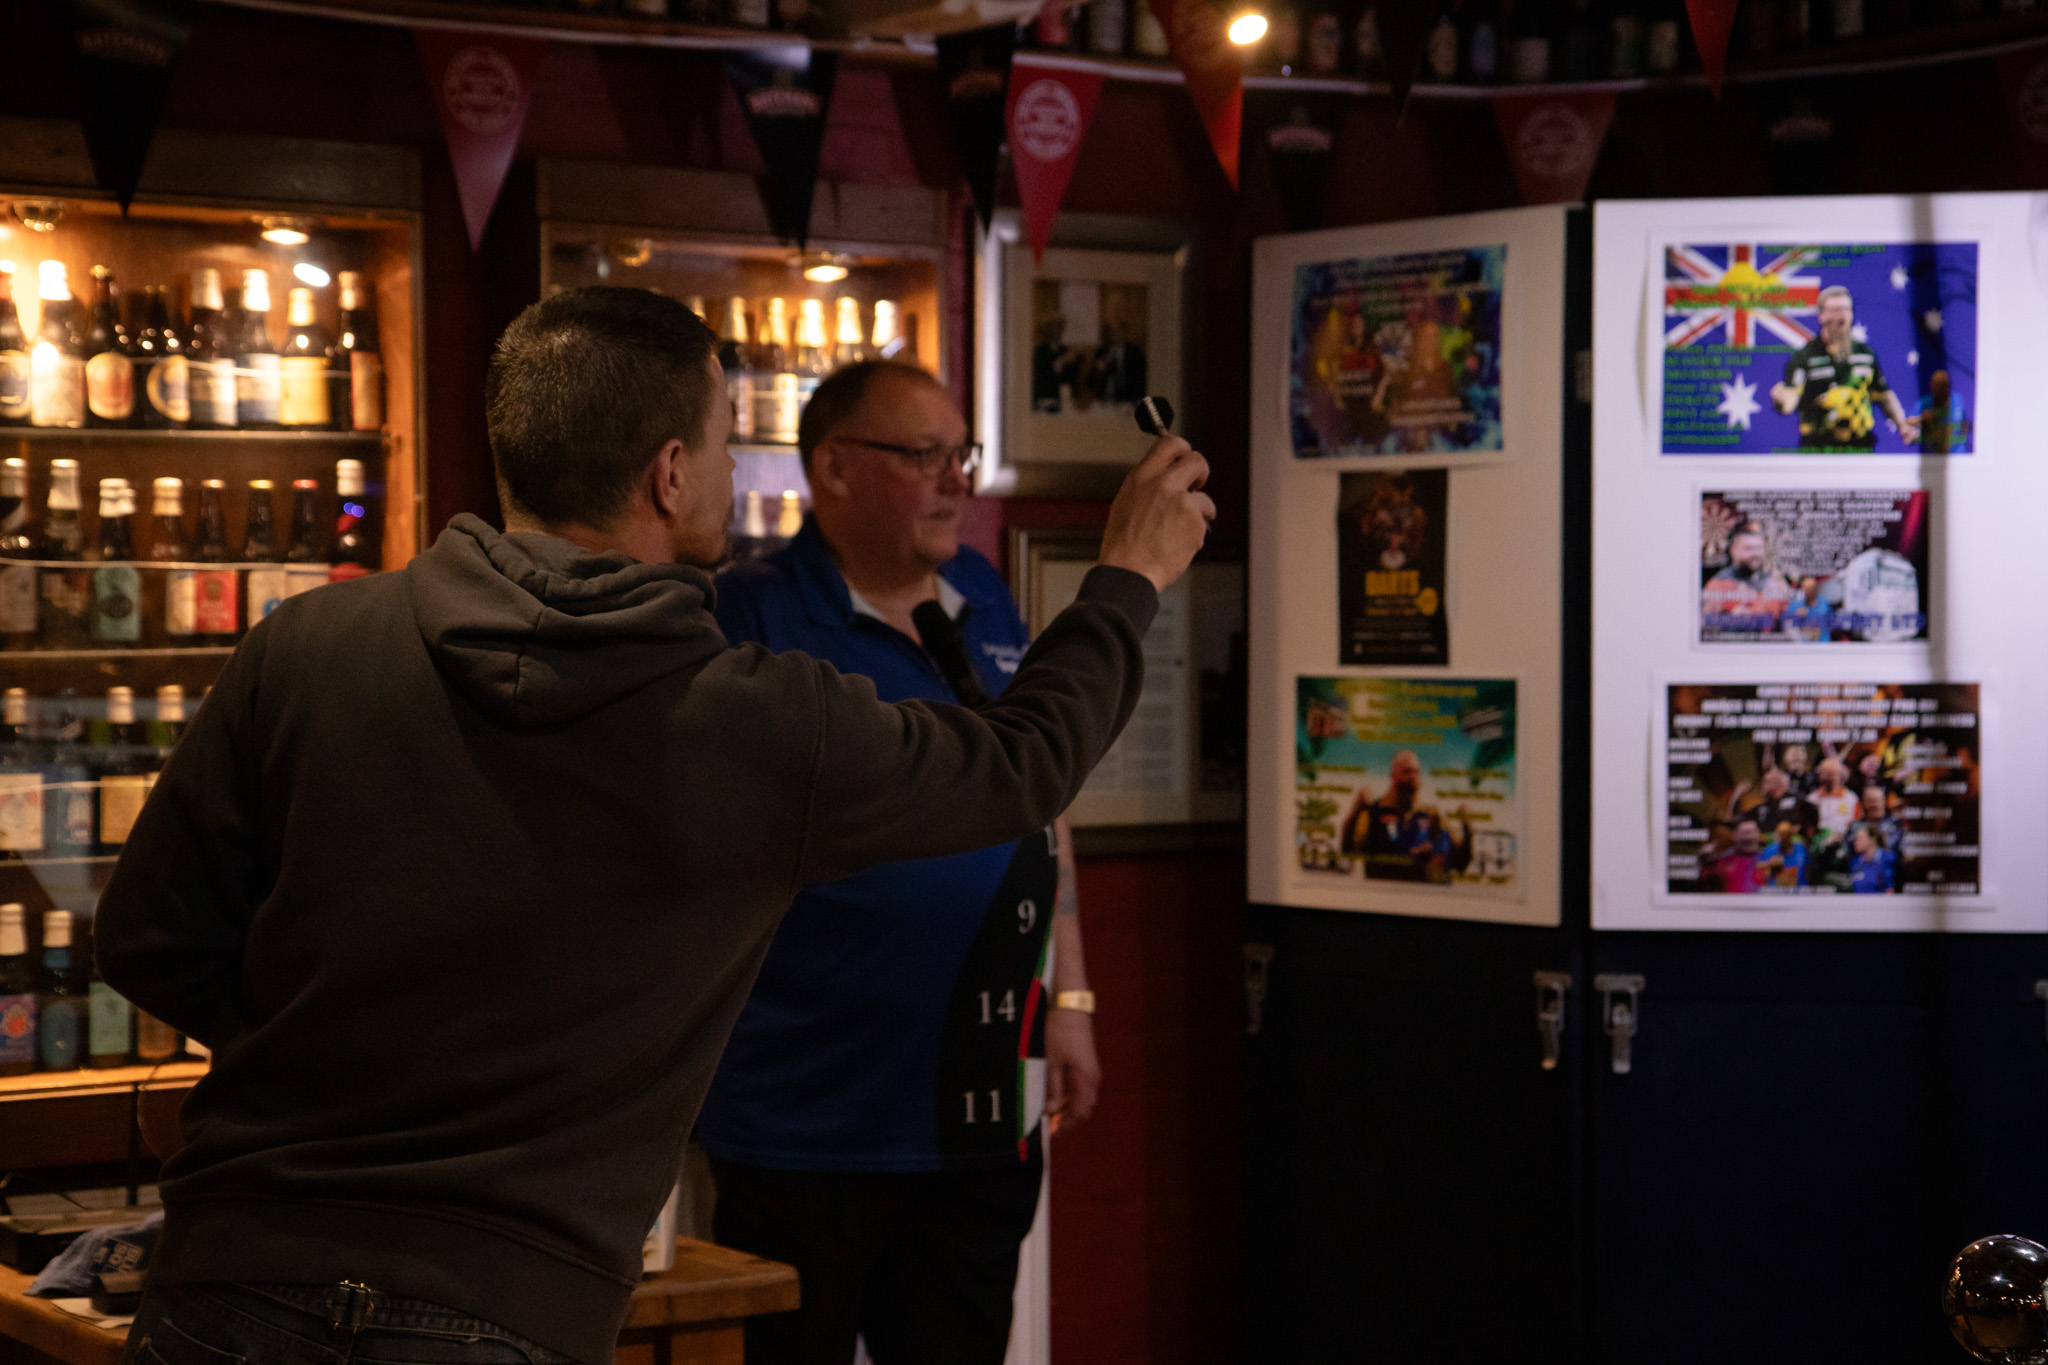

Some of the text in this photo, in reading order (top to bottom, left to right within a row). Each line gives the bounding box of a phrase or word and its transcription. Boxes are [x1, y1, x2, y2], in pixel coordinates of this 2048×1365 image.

[1017, 899, 1037, 935] 9
[978, 989, 1016, 1024] 14
[962, 1089, 1002, 1124] 11
